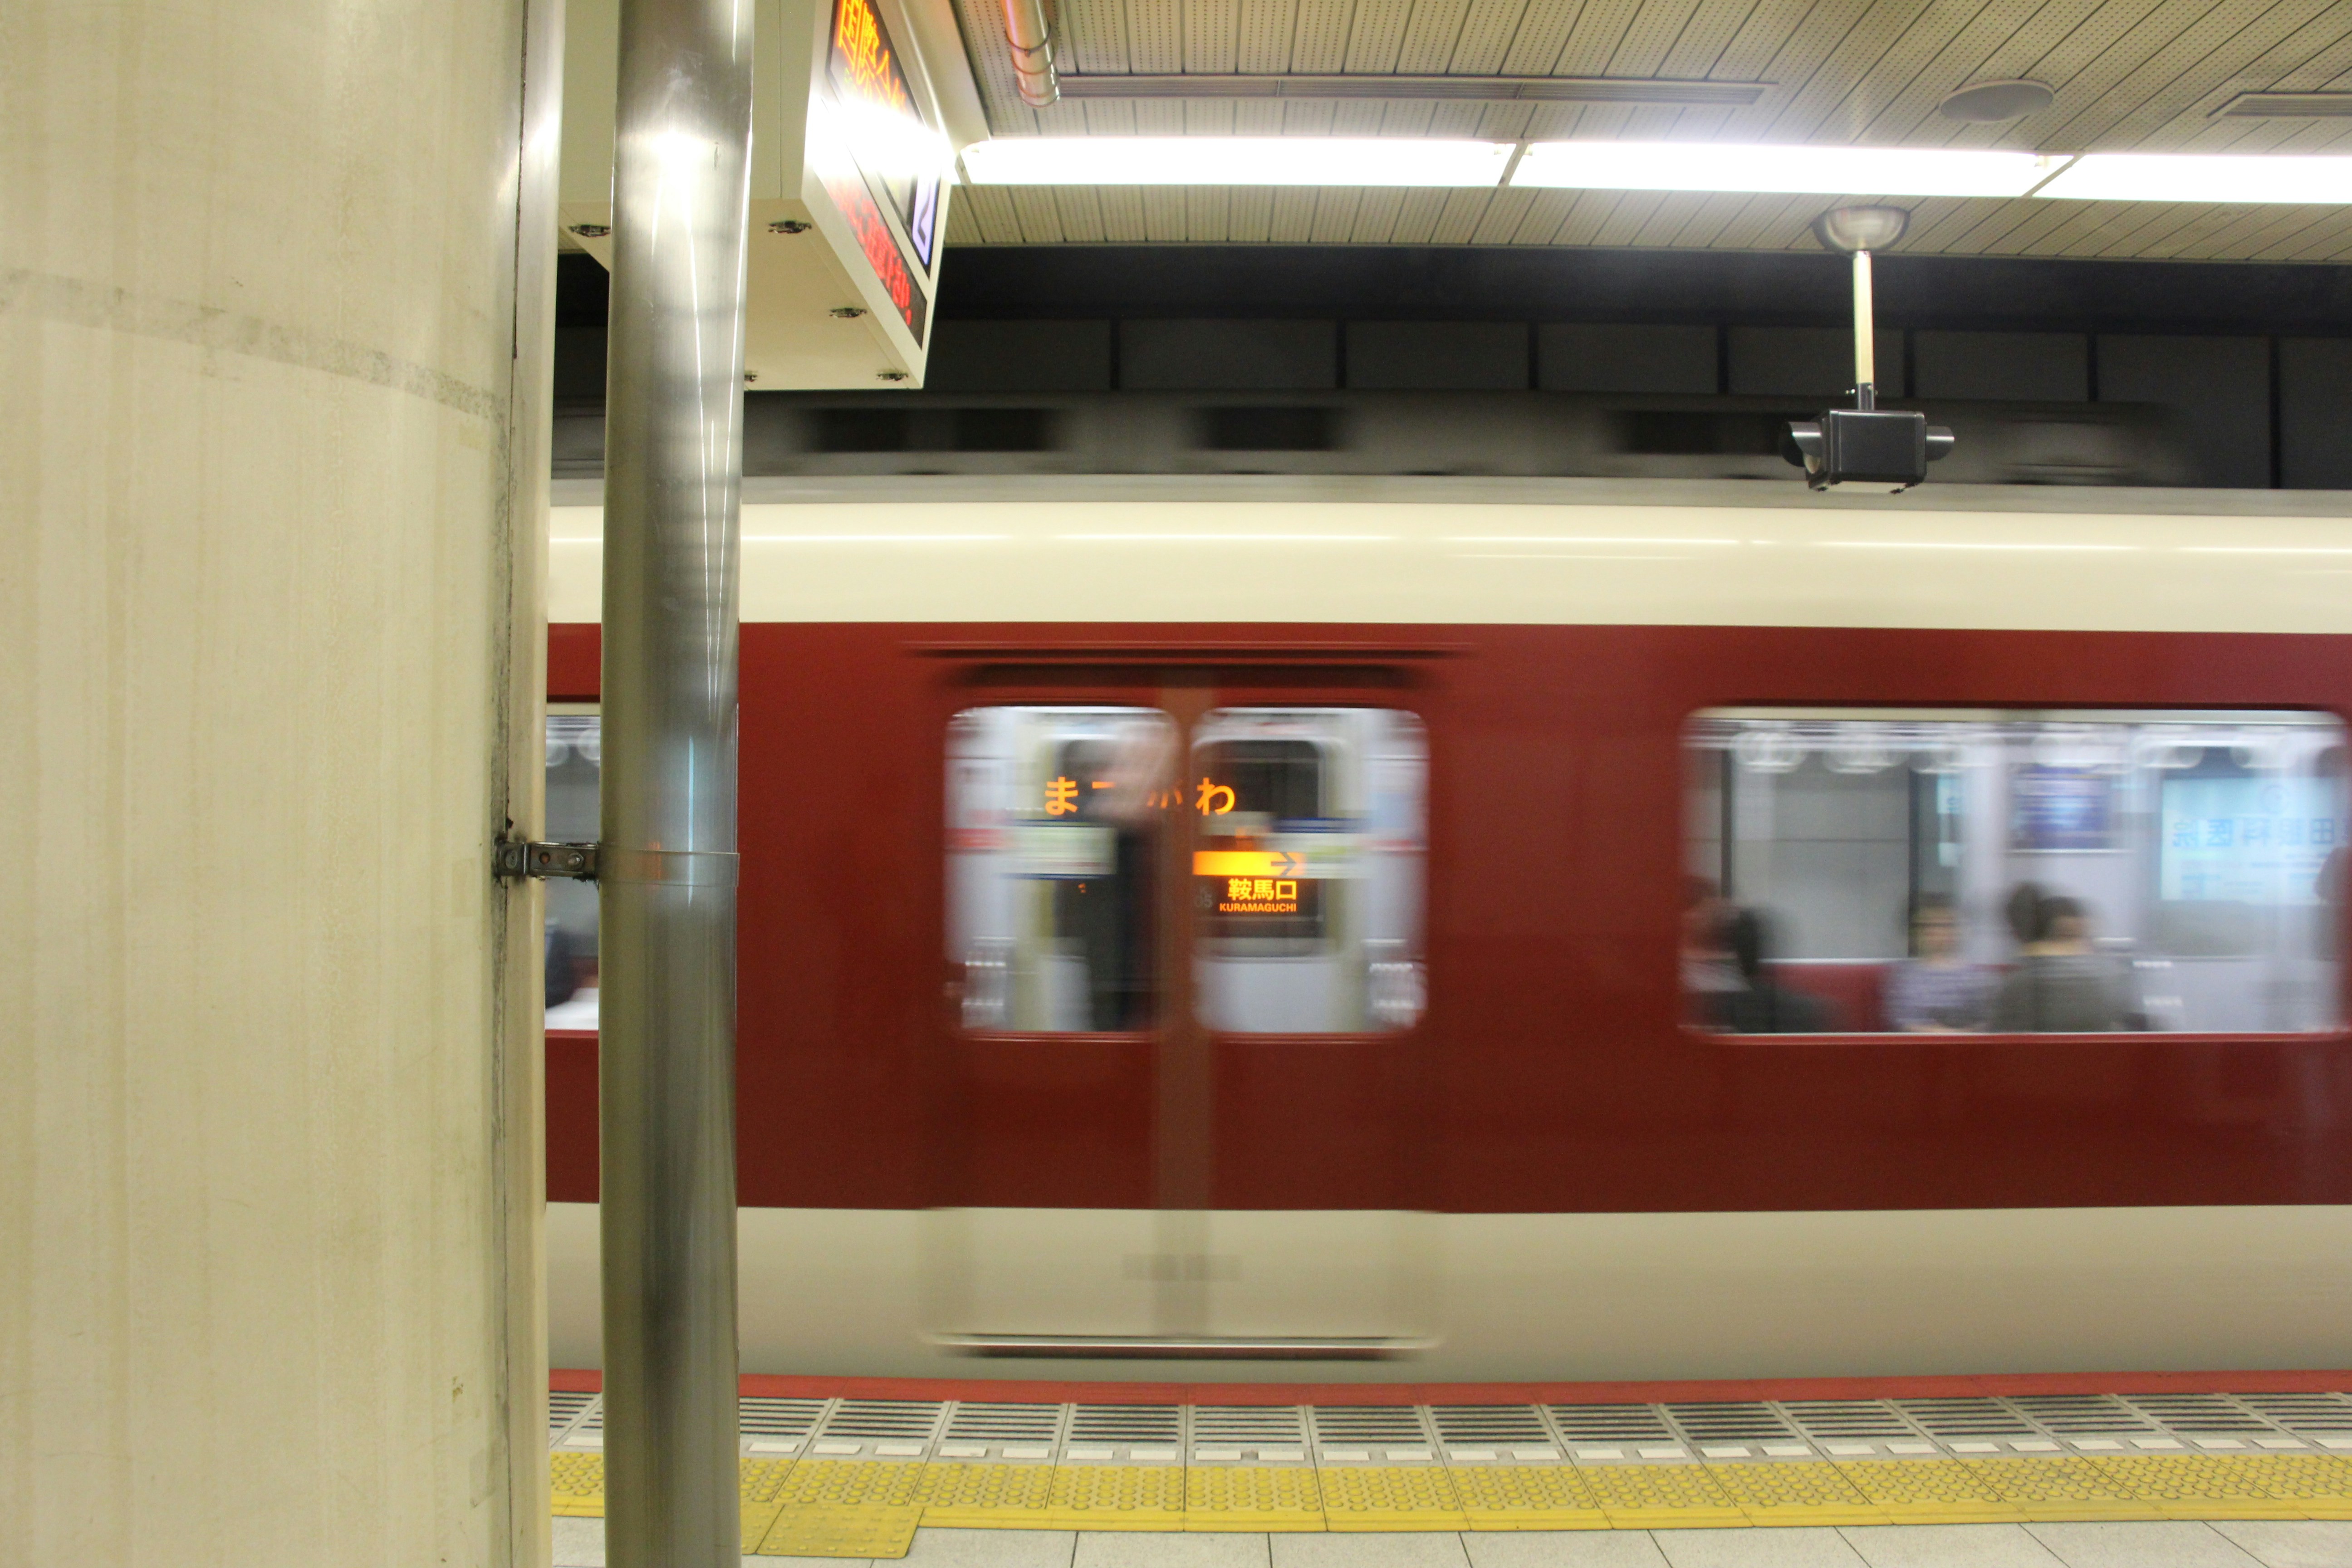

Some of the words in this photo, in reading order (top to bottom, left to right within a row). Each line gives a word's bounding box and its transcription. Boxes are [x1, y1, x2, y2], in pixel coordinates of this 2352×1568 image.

[838, 0, 907, 113] 国際会
[1227, 878, 1297, 901] 鞍馬口
[1219, 903, 1297, 912] KURAMAGUCHI
